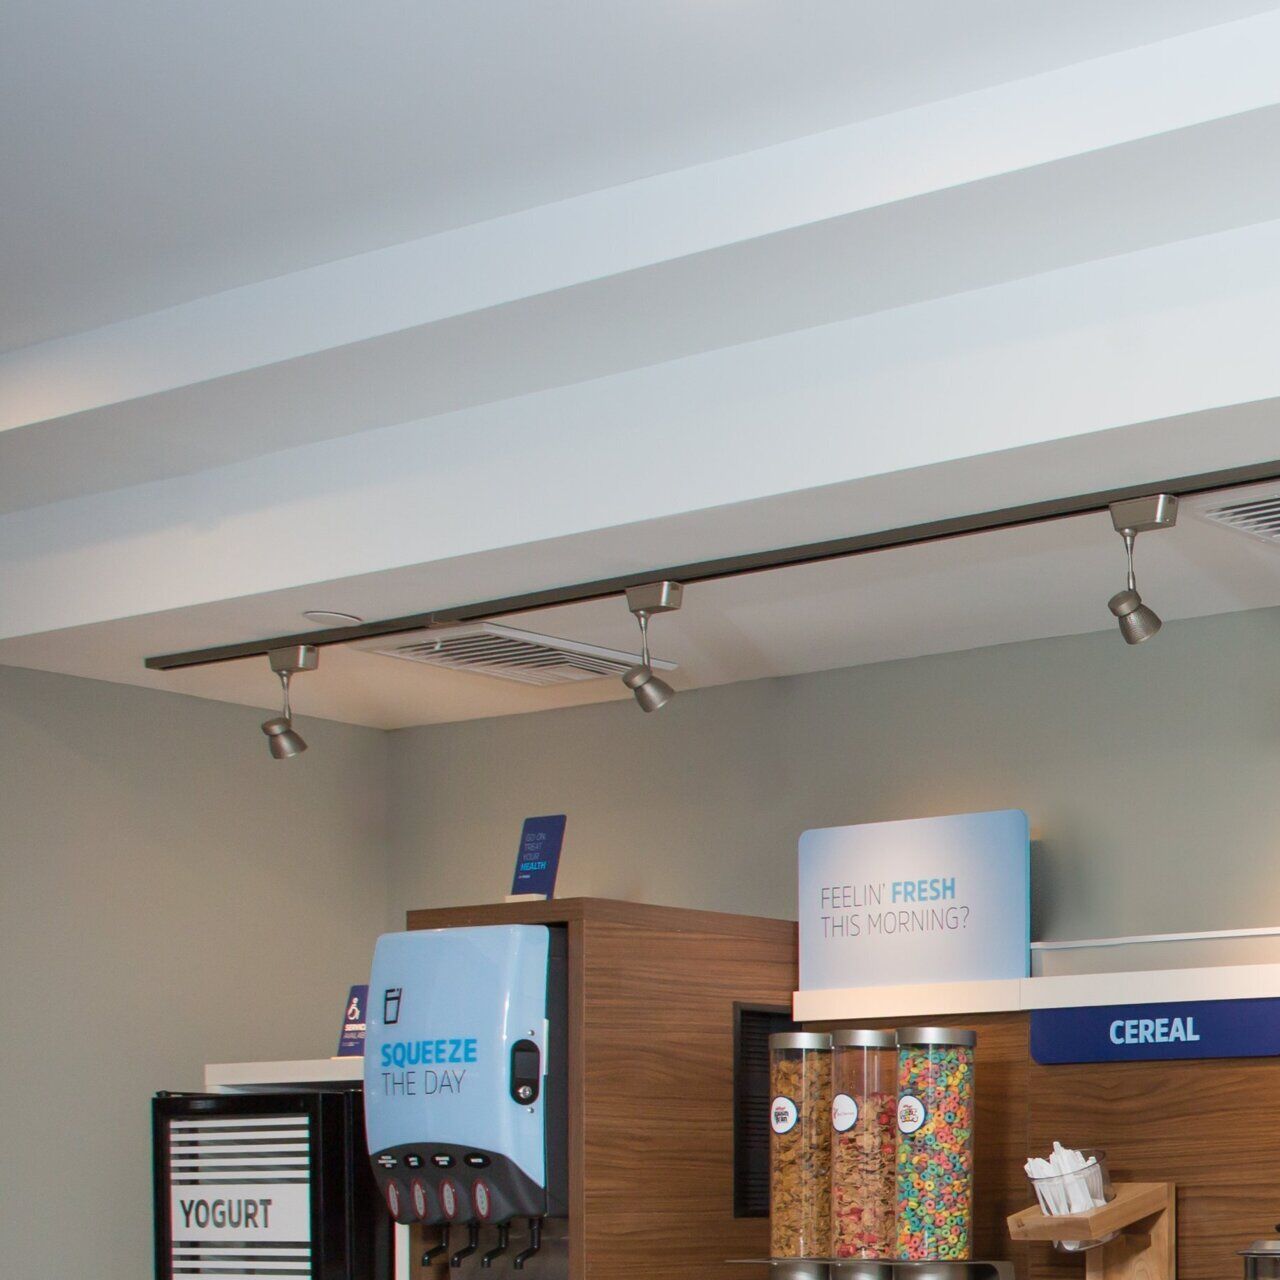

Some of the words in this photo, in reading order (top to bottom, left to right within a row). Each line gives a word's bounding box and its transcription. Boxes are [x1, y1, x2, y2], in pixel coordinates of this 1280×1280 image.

[820, 883, 887, 909] FEELIN'
[891, 876, 956, 904] FRESH
[820, 914, 861, 940] THIS
[866, 904, 970, 936] MORNING?
[1109, 1016, 1200, 1046] CEREAL
[381, 1038, 478, 1068] SQUEEZE
[381, 1071, 416, 1096] THE
[425, 1069, 466, 1095] DAY
[180, 1198, 272, 1229] YOGURT
